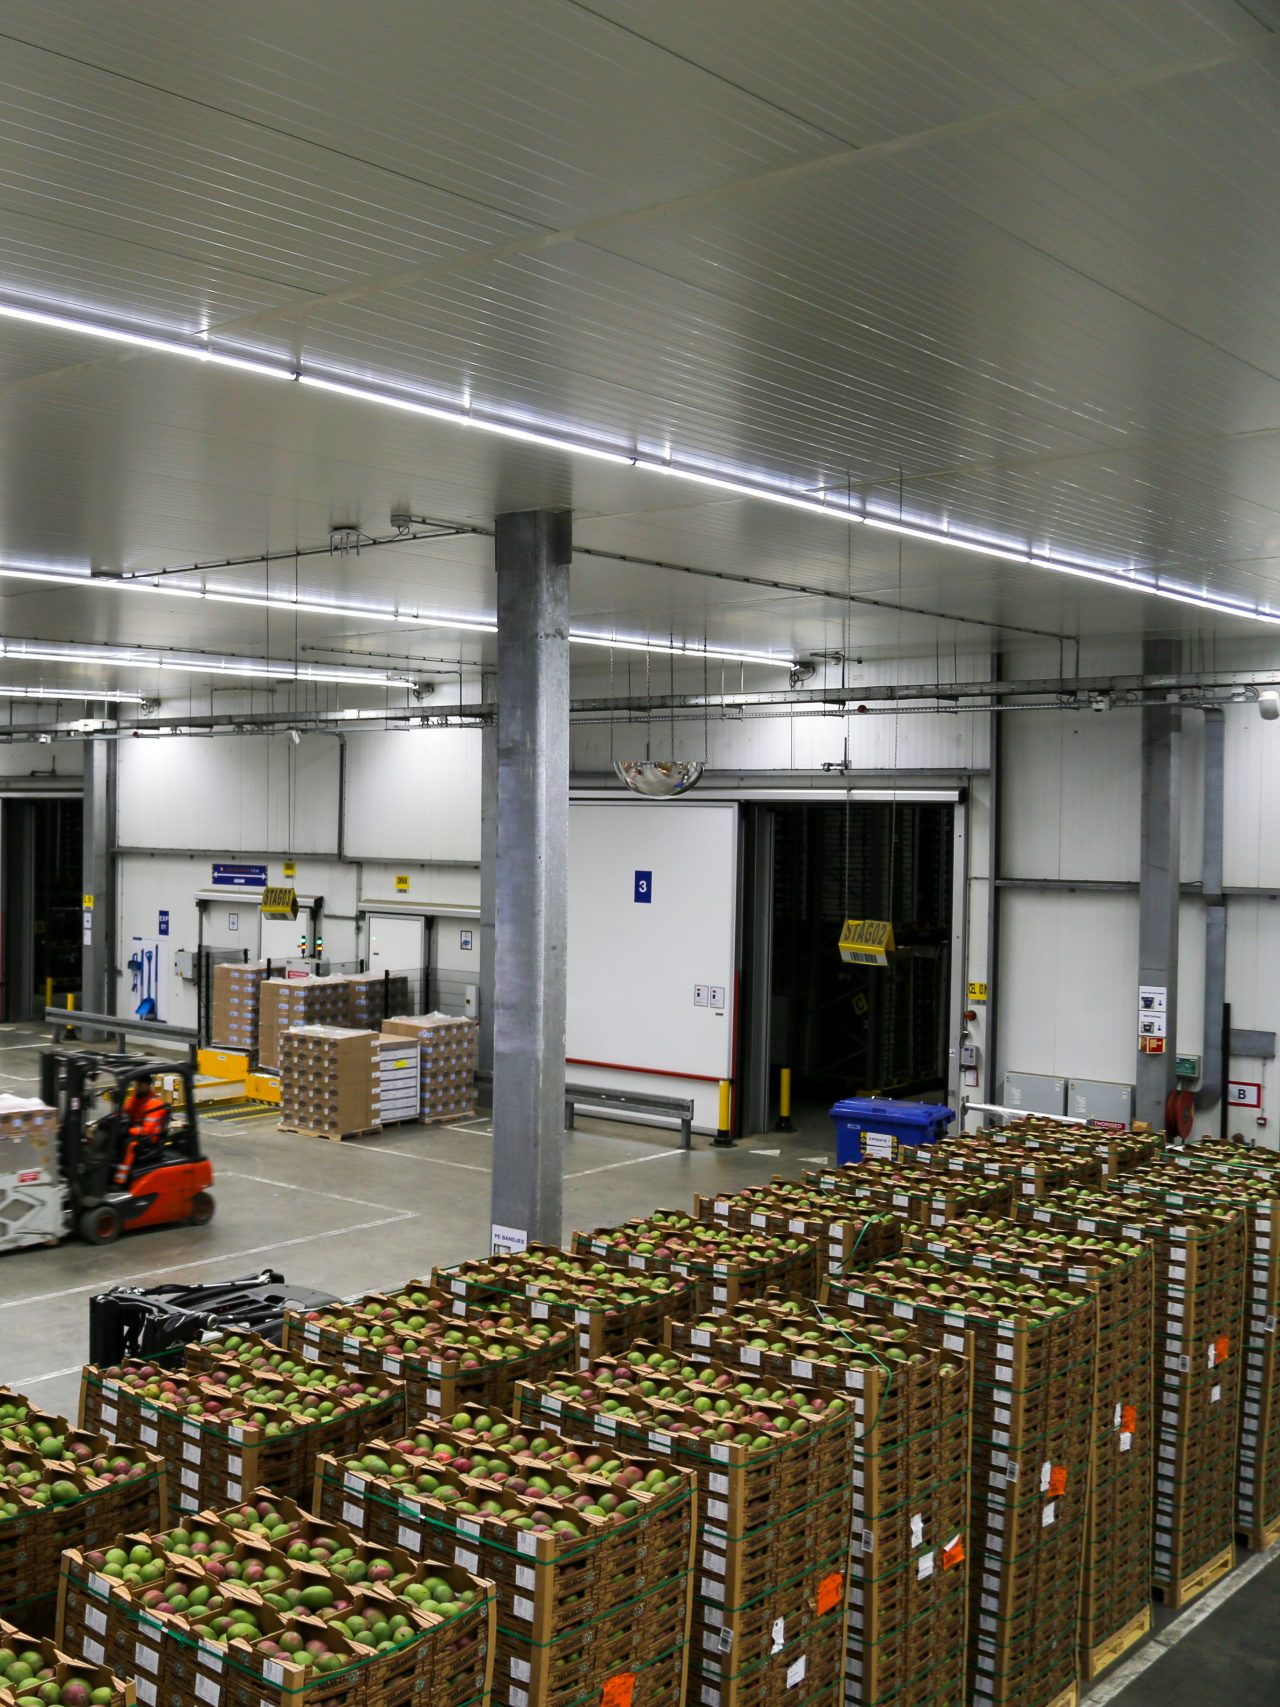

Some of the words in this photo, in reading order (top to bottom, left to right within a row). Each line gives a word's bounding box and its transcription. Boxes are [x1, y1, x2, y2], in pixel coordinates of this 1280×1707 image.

[639, 880, 648, 893] 3
[264, 887, 292, 906] STAG03
[844, 923, 888, 945] STAG02
[968, 983, 977, 994] CEL
[1237, 1089, 1247, 1100] B
[1094, 1121, 1122, 1129] THORISED
[502, 1235, 525, 1244] BANDJES
